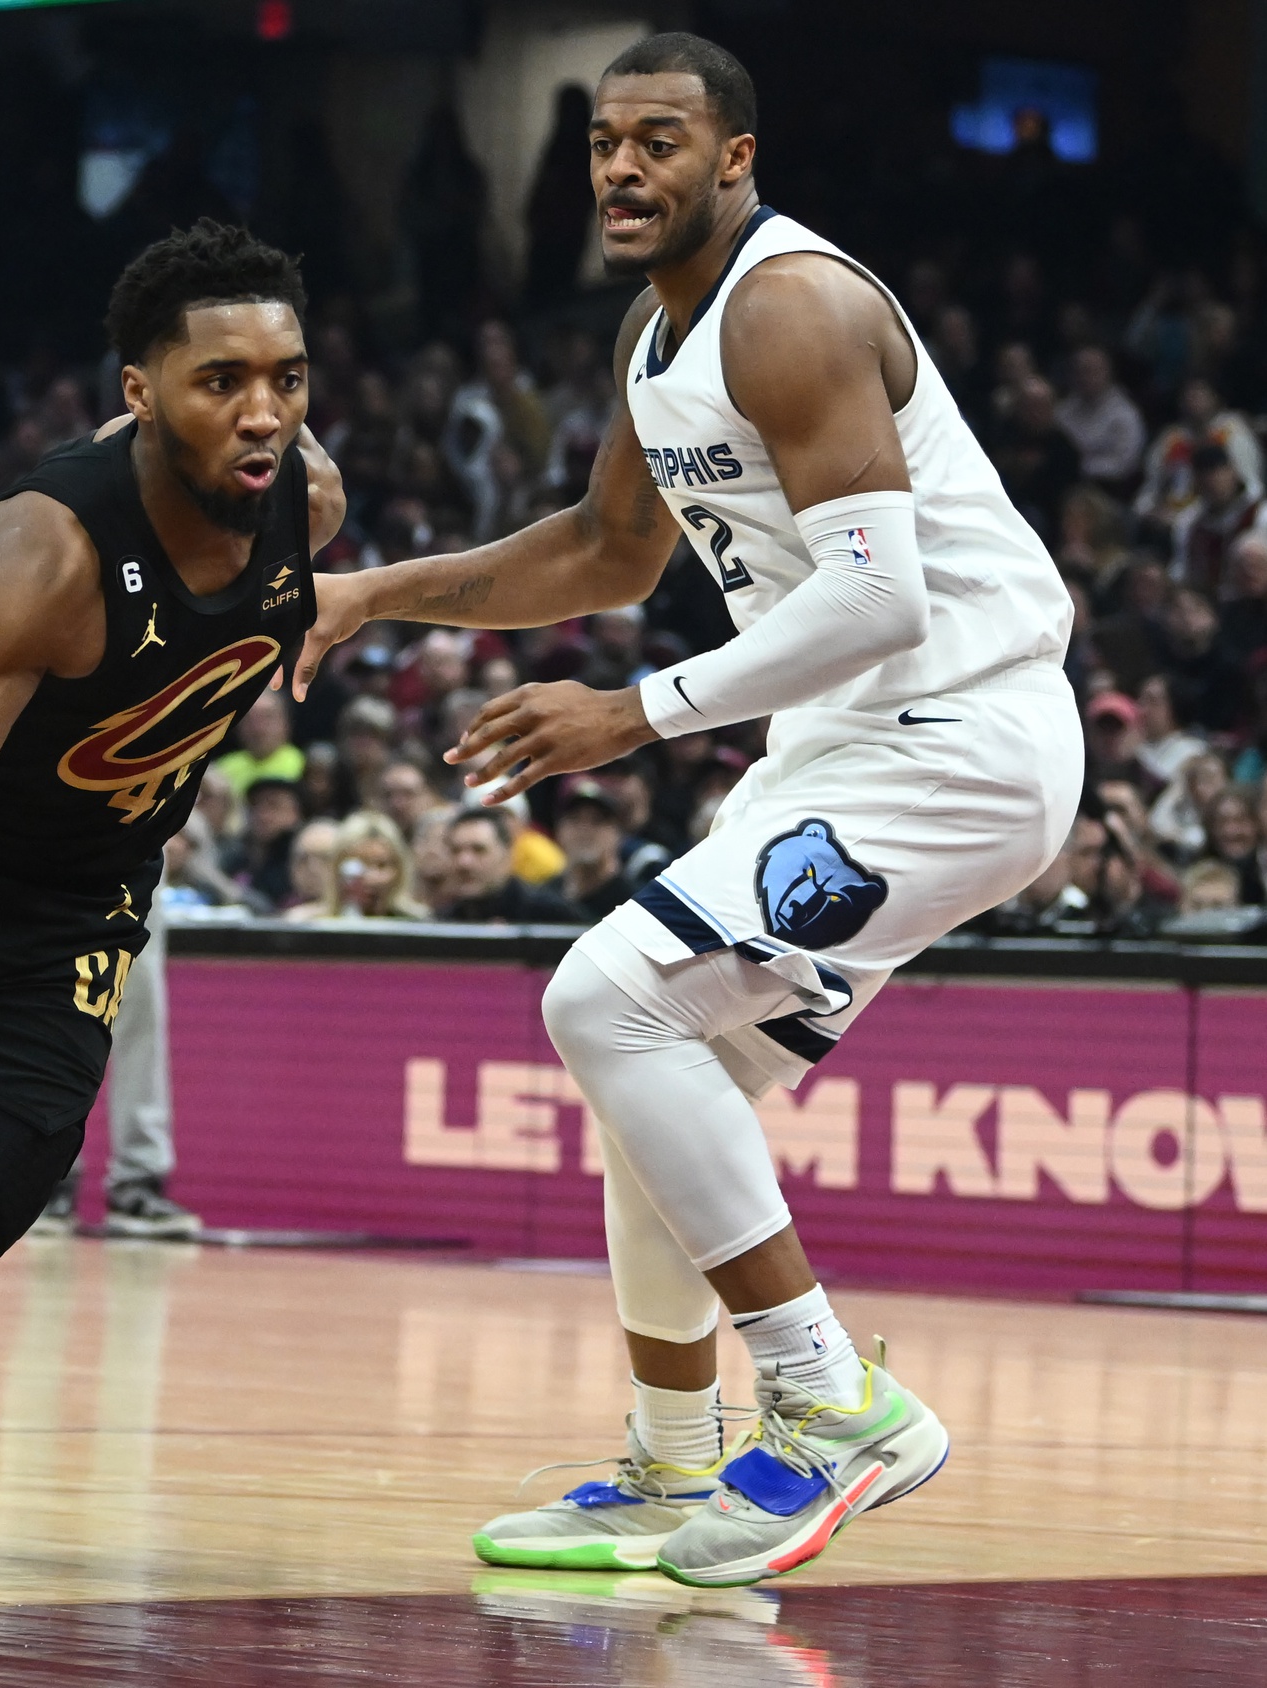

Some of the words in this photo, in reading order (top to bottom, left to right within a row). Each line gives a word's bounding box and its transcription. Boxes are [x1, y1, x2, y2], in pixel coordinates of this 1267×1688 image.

[680, 504, 755, 593] 2
[122, 561, 144, 593] 6
[262, 587, 300, 611] CLIFFS
